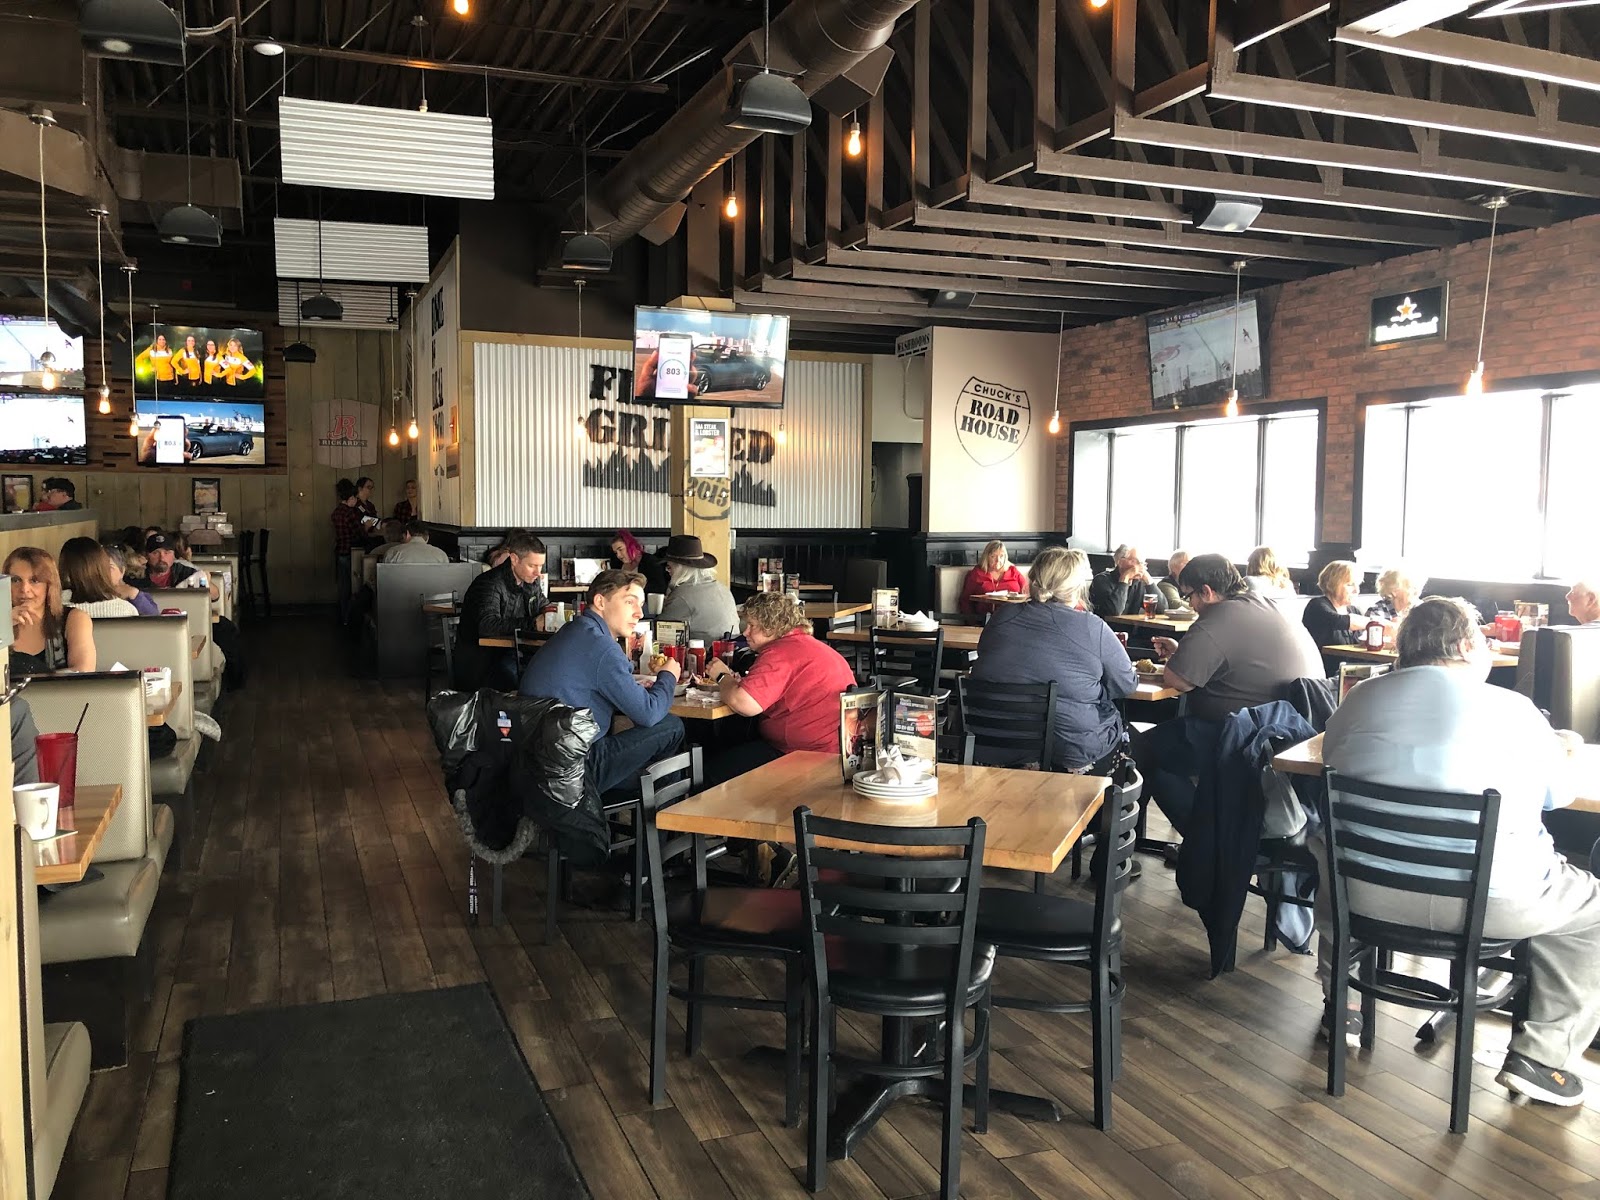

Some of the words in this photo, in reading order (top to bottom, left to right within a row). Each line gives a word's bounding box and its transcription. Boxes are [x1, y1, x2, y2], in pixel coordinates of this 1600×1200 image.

[666, 367, 681, 376] 803
[974, 384, 1021, 403] CHUCK'S
[969, 399, 1020, 426] ROAD
[960, 415, 1020, 444] HOUSE
[686, 477, 729, 507] 2015
